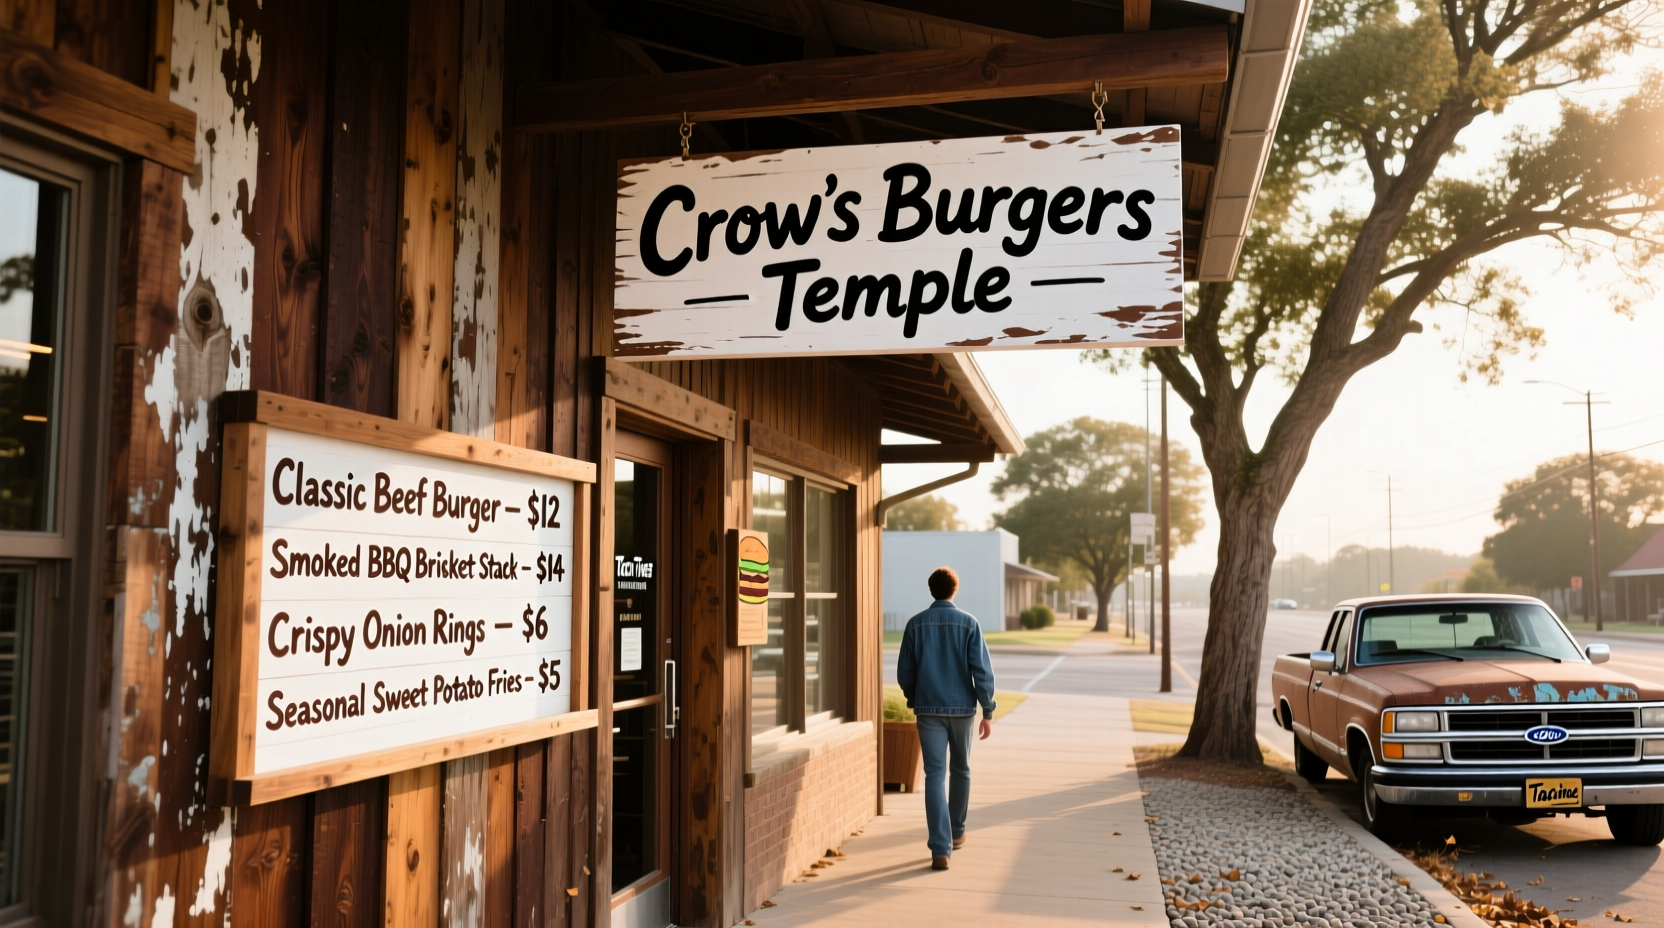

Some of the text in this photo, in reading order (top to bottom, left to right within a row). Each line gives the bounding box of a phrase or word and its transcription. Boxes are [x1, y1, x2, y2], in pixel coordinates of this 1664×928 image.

[639, 163, 1156, 276] Crow's Burgers
[762, 247, 1013, 338] Temple
[273, 458, 366, 510] Classic
[374, 472, 428, 516] Beef
[433, 481, 501, 533] Burger
[528, 489, 560, 530] $12
[270, 539, 360, 578] Smoked
[368, 545, 411, 583] BBQ
[416, 548, 476, 579] Brisket
[479, 553, 517, 580] Stack
[537, 551, 565, 584] $14
[268, 612, 355, 666] Crispy
[363, 610, 426, 649] Onion
[434, 609, 485, 656] Rings
[523, 603, 548, 643] $6
[266, 683, 365, 730] Seasonal
[373, 679, 428, 713] Sweet
[434, 675, 483, 705] Potato
[489, 668, 522, 696] Fries
[539, 658, 560, 693] $5
